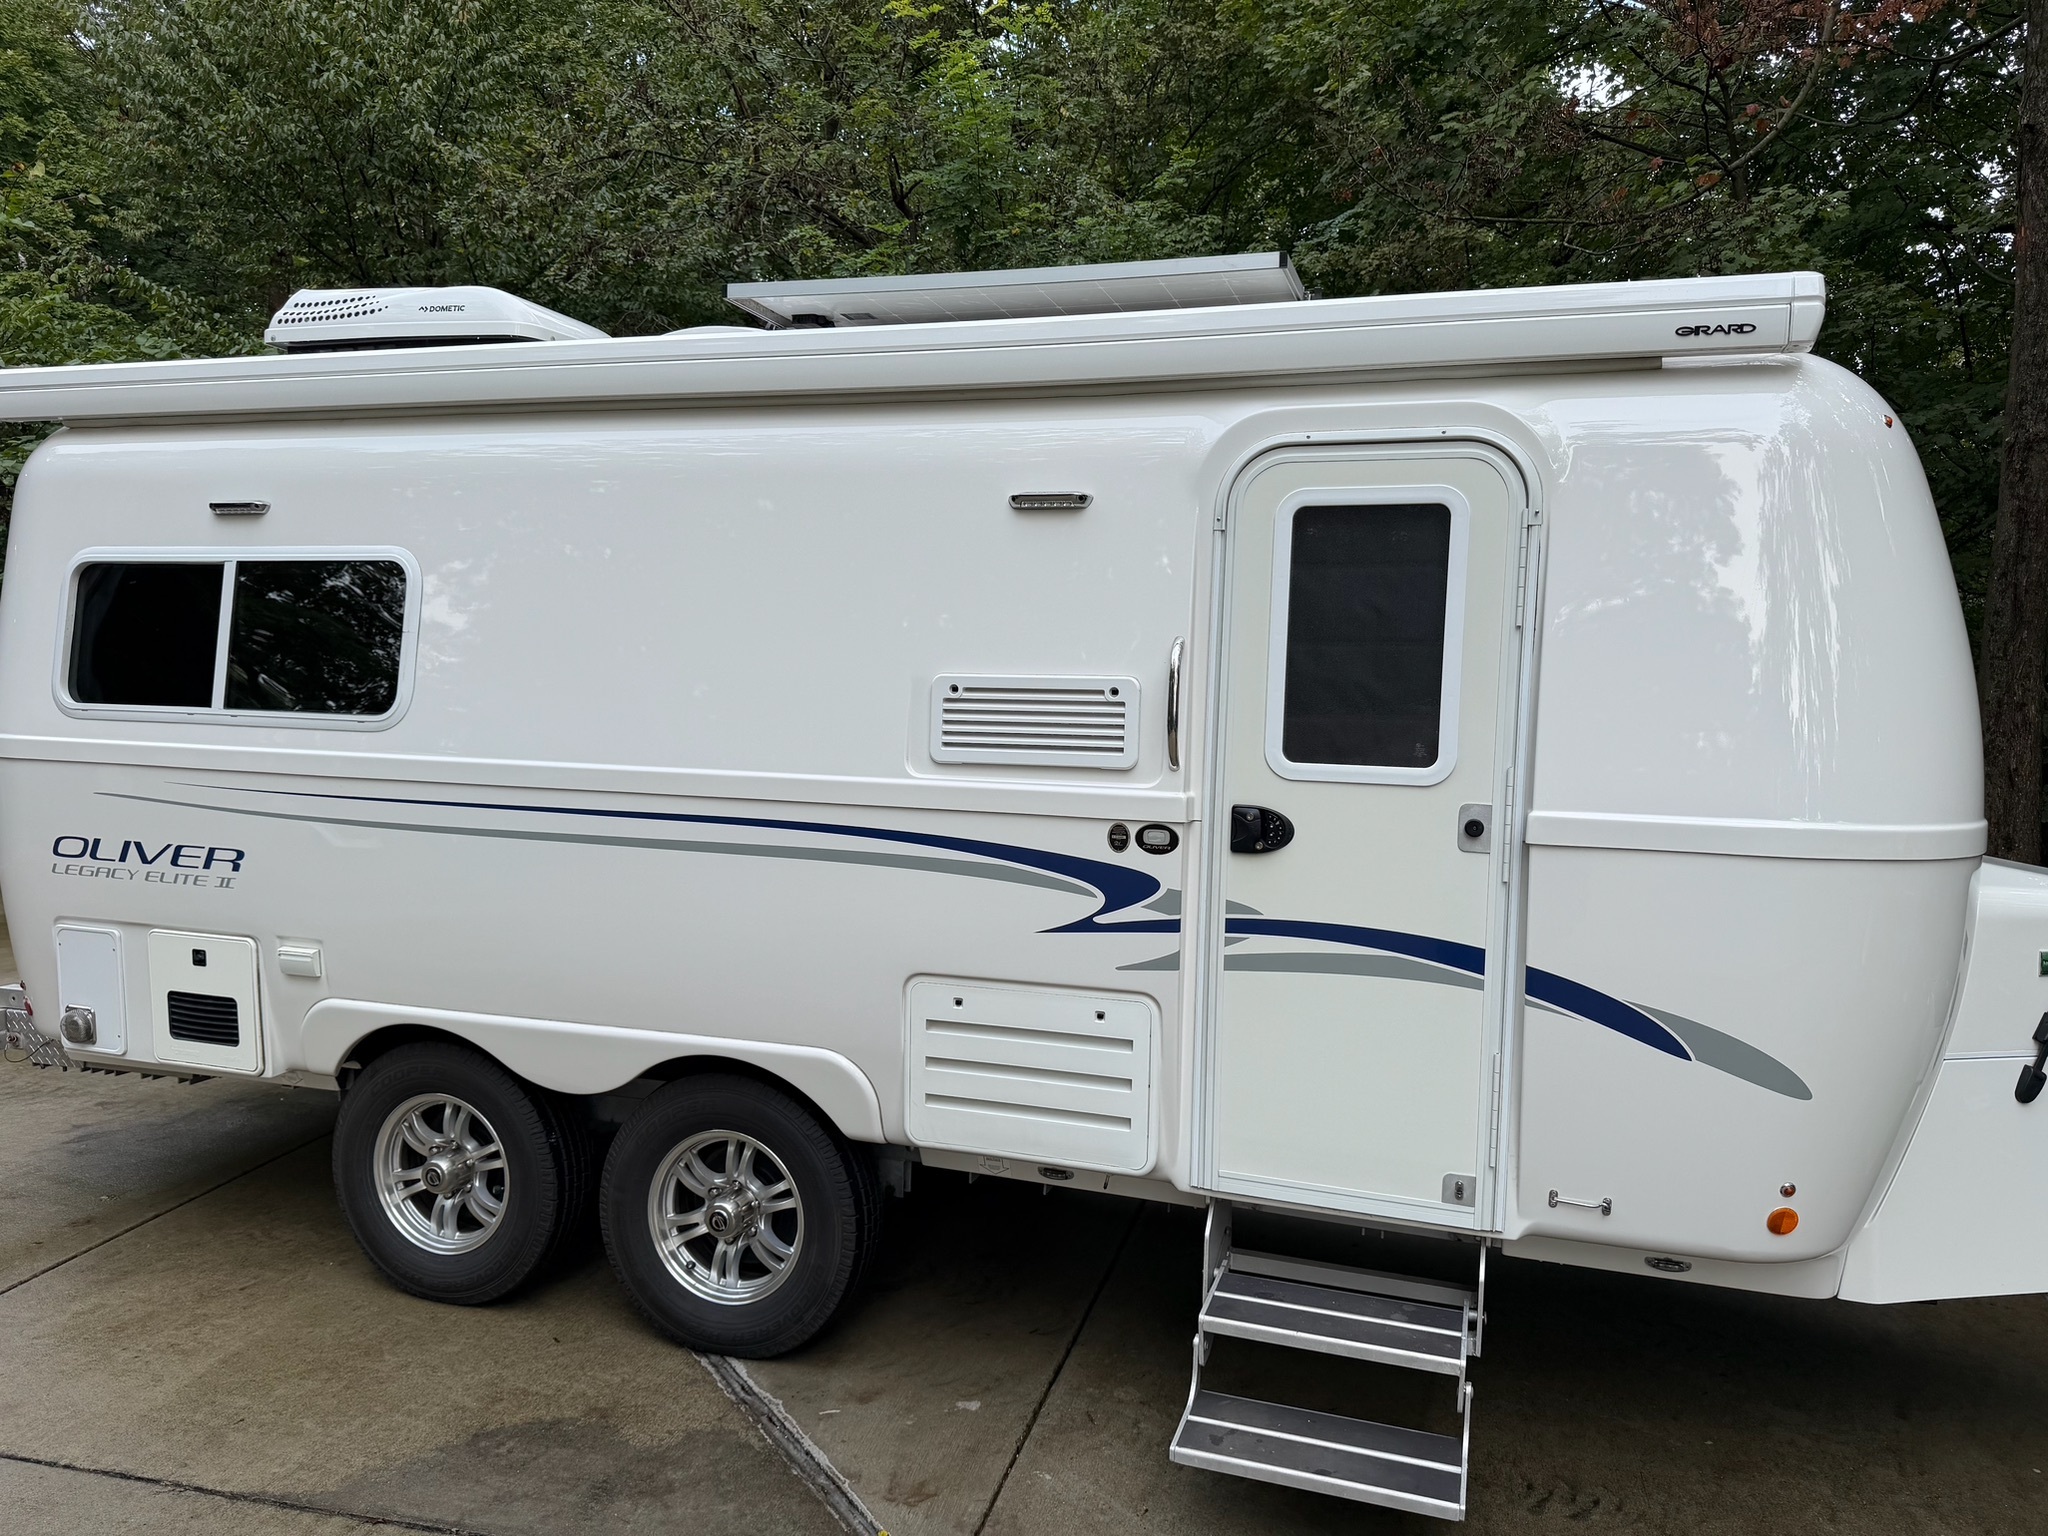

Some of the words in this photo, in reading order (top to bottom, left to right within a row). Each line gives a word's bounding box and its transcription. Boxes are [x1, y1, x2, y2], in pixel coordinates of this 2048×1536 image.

[1675, 323, 1757, 337] GIRARD
[52, 835, 246, 872] OLIVER
[51, 863, 140, 881] LEGACY
[144, 871, 210, 887] ELITE
[213, 876, 237, 889] II
[370, 1064, 447, 1095] COOPER
